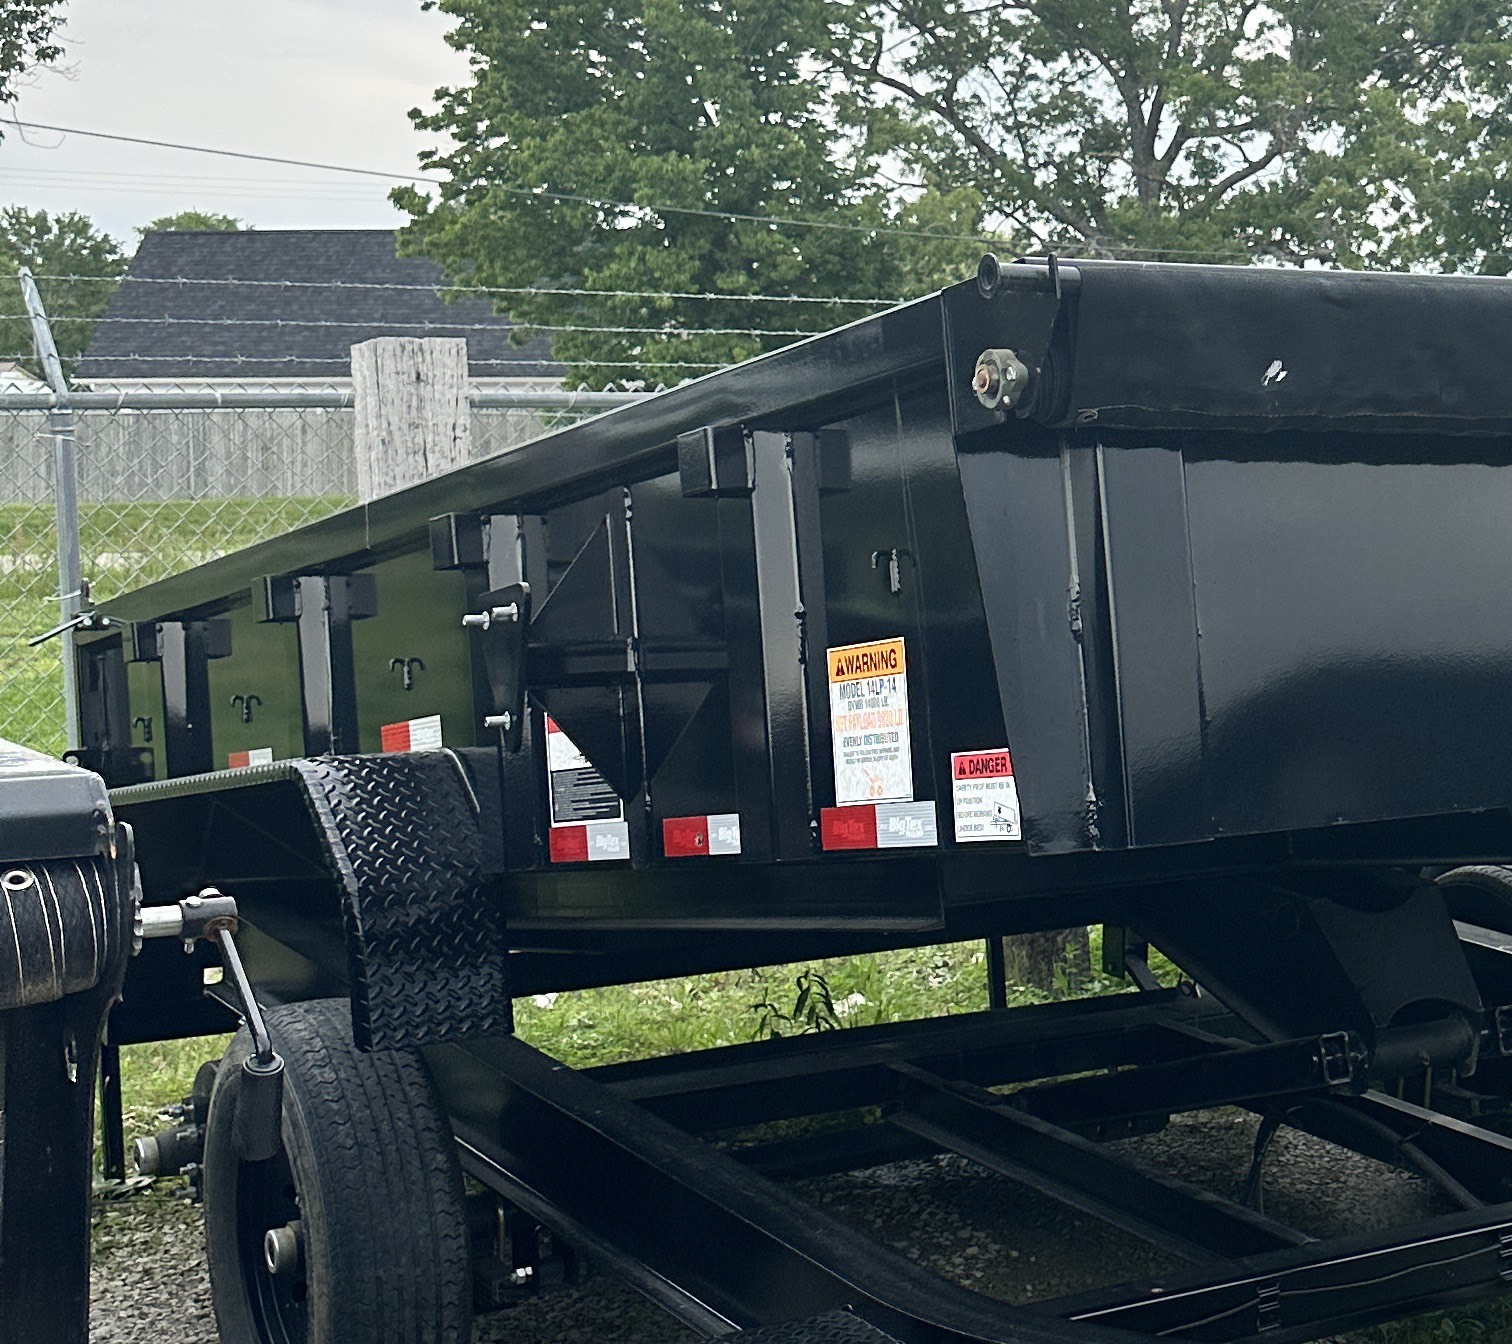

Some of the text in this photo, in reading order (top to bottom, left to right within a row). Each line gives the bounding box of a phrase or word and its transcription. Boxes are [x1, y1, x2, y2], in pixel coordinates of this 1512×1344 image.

[844, 648, 897, 675] WARNING
[840, 677, 896, 700] MODEL 14LP-14
[968, 756, 1007, 775] DANGER
[889, 816, 922, 835] BigTex
